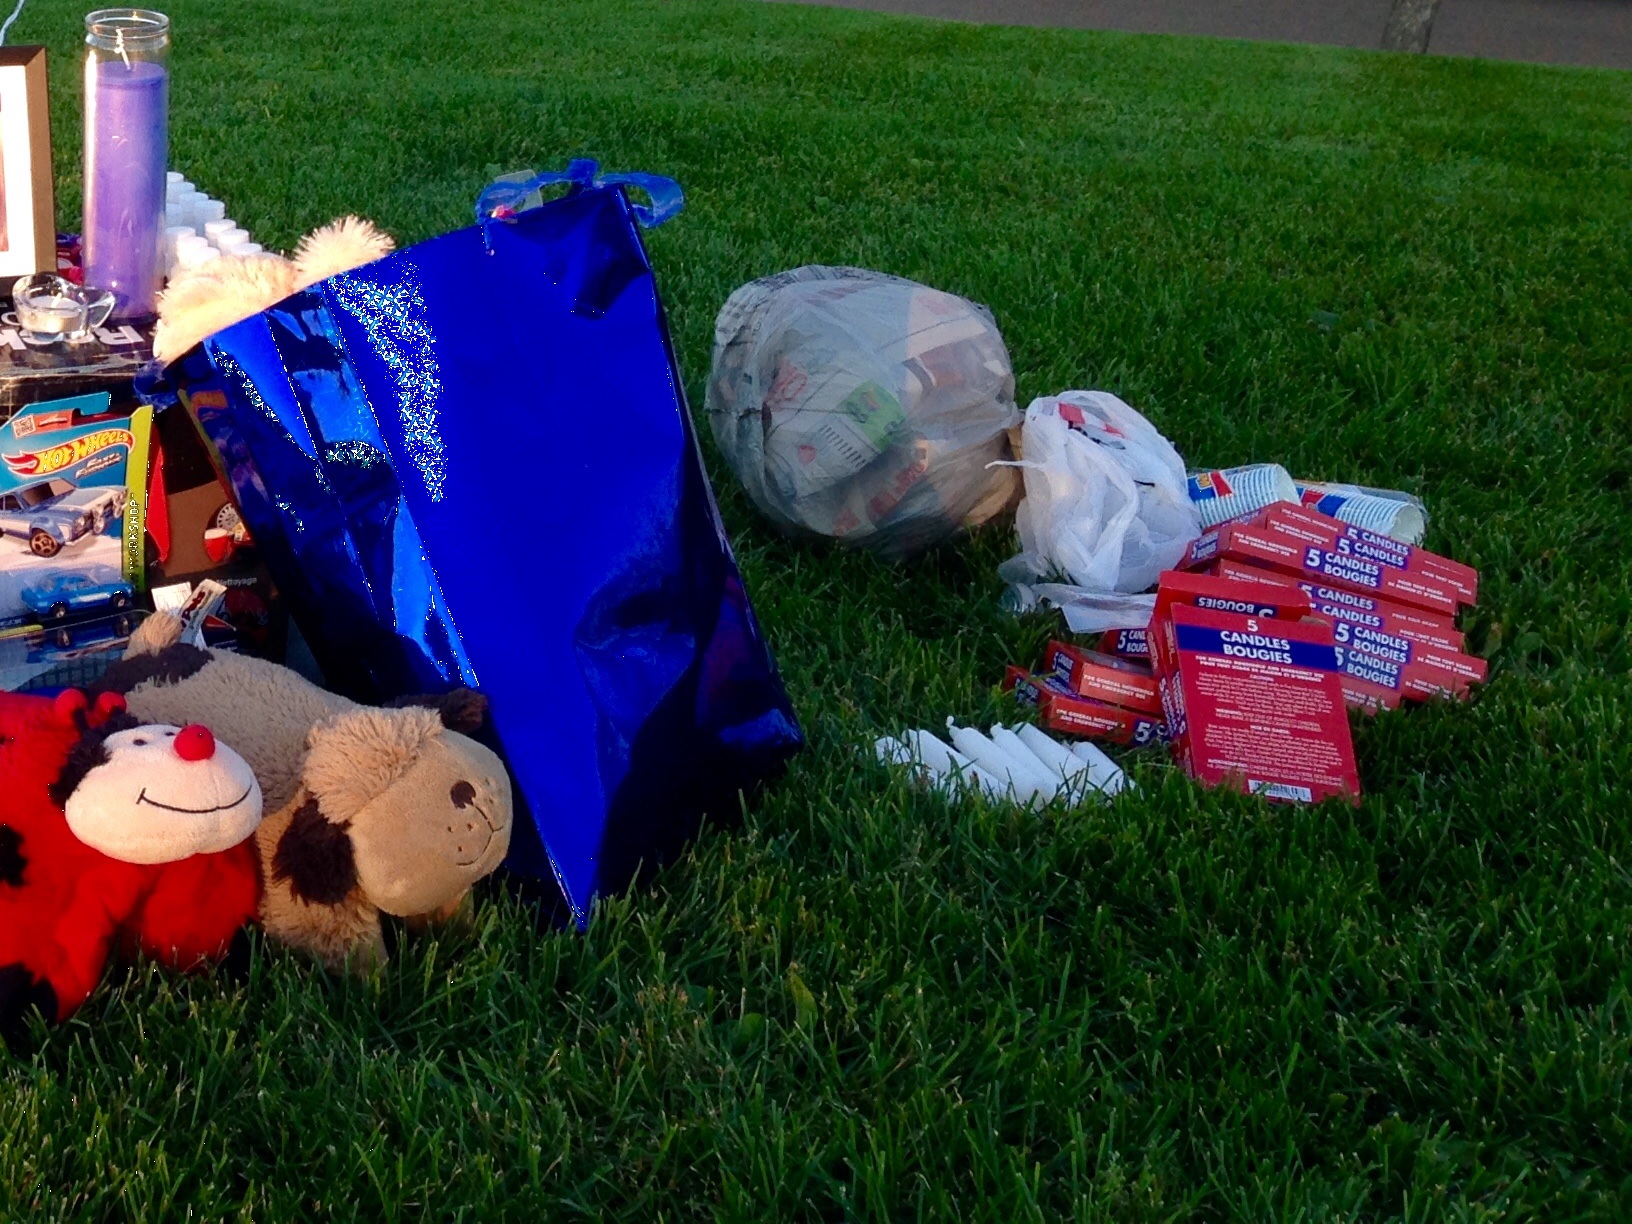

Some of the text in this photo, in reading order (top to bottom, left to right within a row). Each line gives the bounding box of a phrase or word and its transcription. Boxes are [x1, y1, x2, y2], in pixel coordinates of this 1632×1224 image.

[1337, 538, 1350, 554] 5
[1355, 543, 1404, 566] CANDLES
[1362, 532, 1409, 555] CANDLES
[1307, 549, 1321, 567] 5
[1325, 553, 1379, 575] CANDLES
[1324, 564, 1377, 587] BOUGIES
[1198, 596, 1254, 613] BOUGIES
[1318, 588, 1373, 611] CANDLES
[1247, 619, 1258, 632] 5
[1322, 603, 1380, 627] CANDLES
[1118, 631, 1128, 649] 5
[1220, 631, 1290, 650] CANDLES
[1335, 623, 1349, 642] 5
[1354, 627, 1409, 650] CANDLES
[1223, 644, 1292, 664] BOUGIES
[1353, 639, 1407, 663] BOUGIES
[1349, 651, 1398, 675] CANDLES
[1347, 663, 1396, 688] BOUGIES
[1135, 721, 1150, 742] 5
